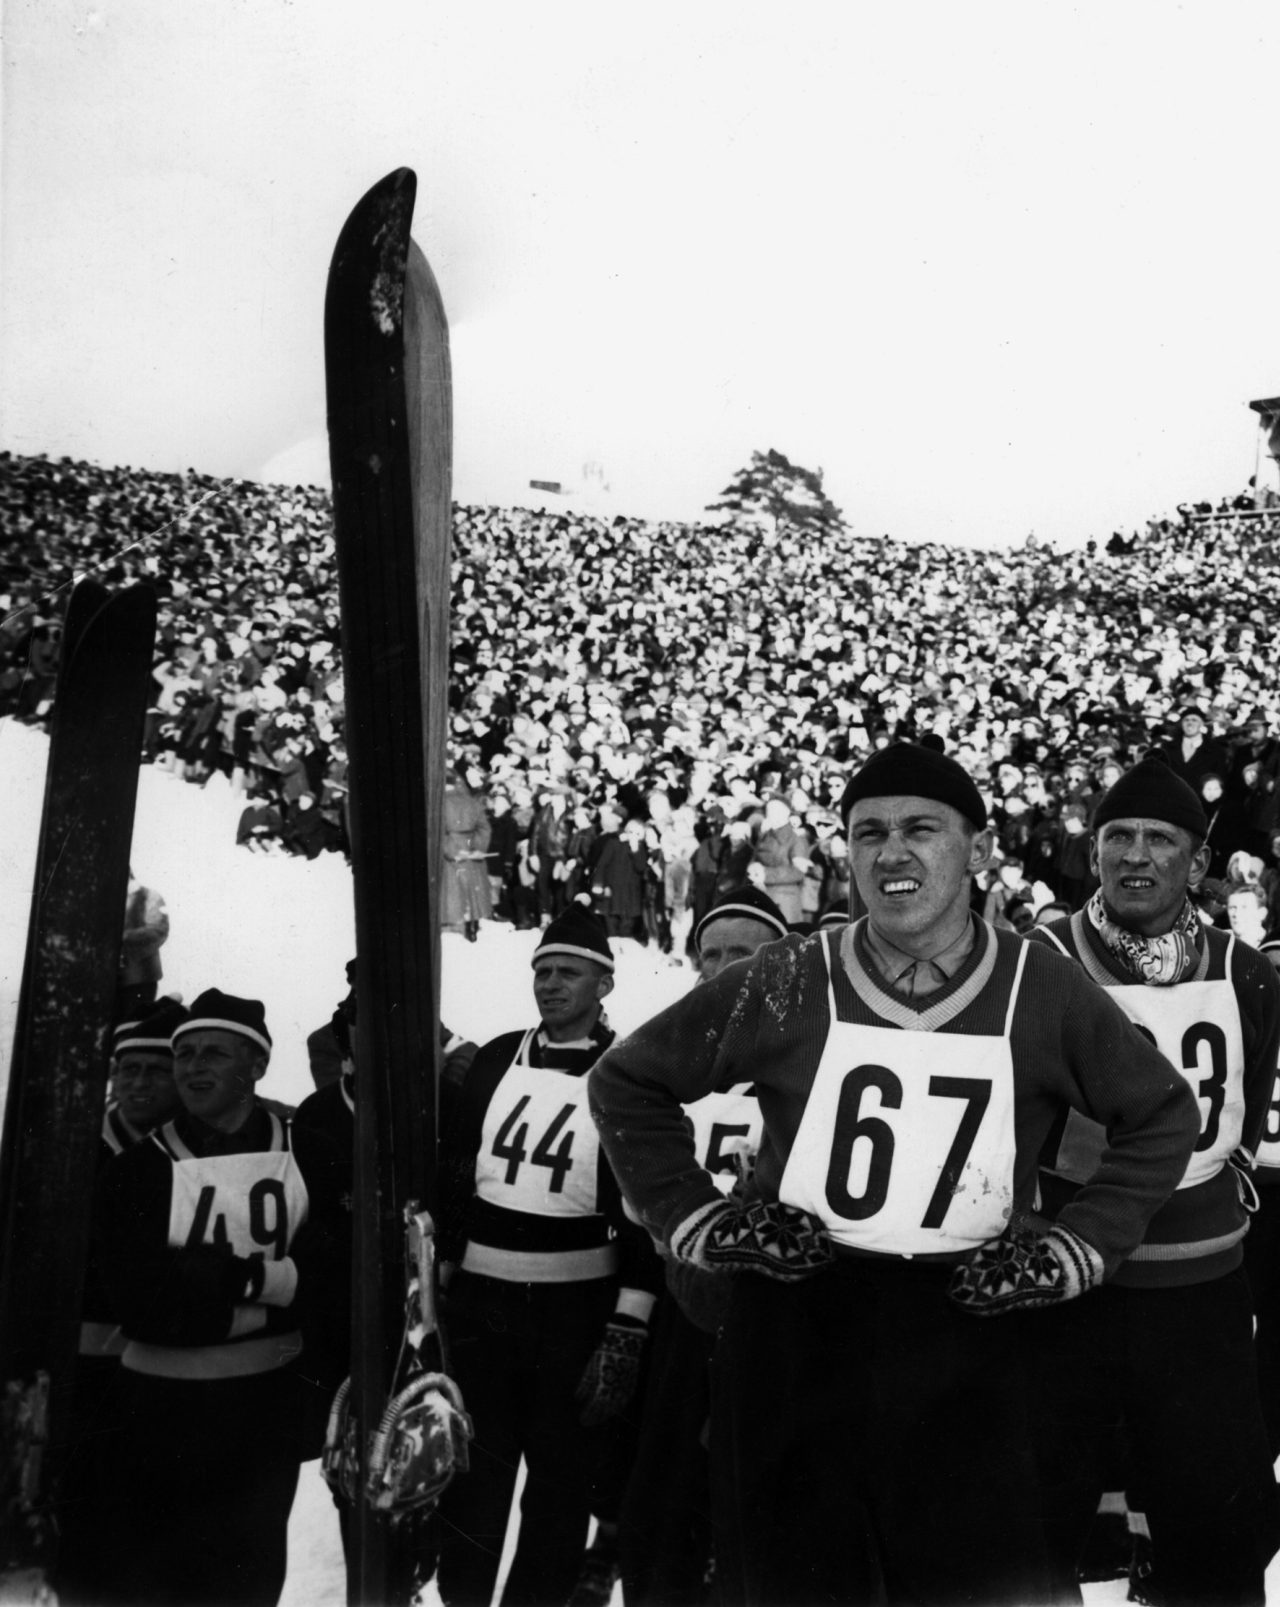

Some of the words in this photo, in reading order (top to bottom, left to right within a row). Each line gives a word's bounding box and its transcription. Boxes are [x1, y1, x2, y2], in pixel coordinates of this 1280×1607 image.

[491, 1095, 577, 1193] 44
[825, 1064, 992, 1228] 67
[185, 1178, 289, 1262] 49
